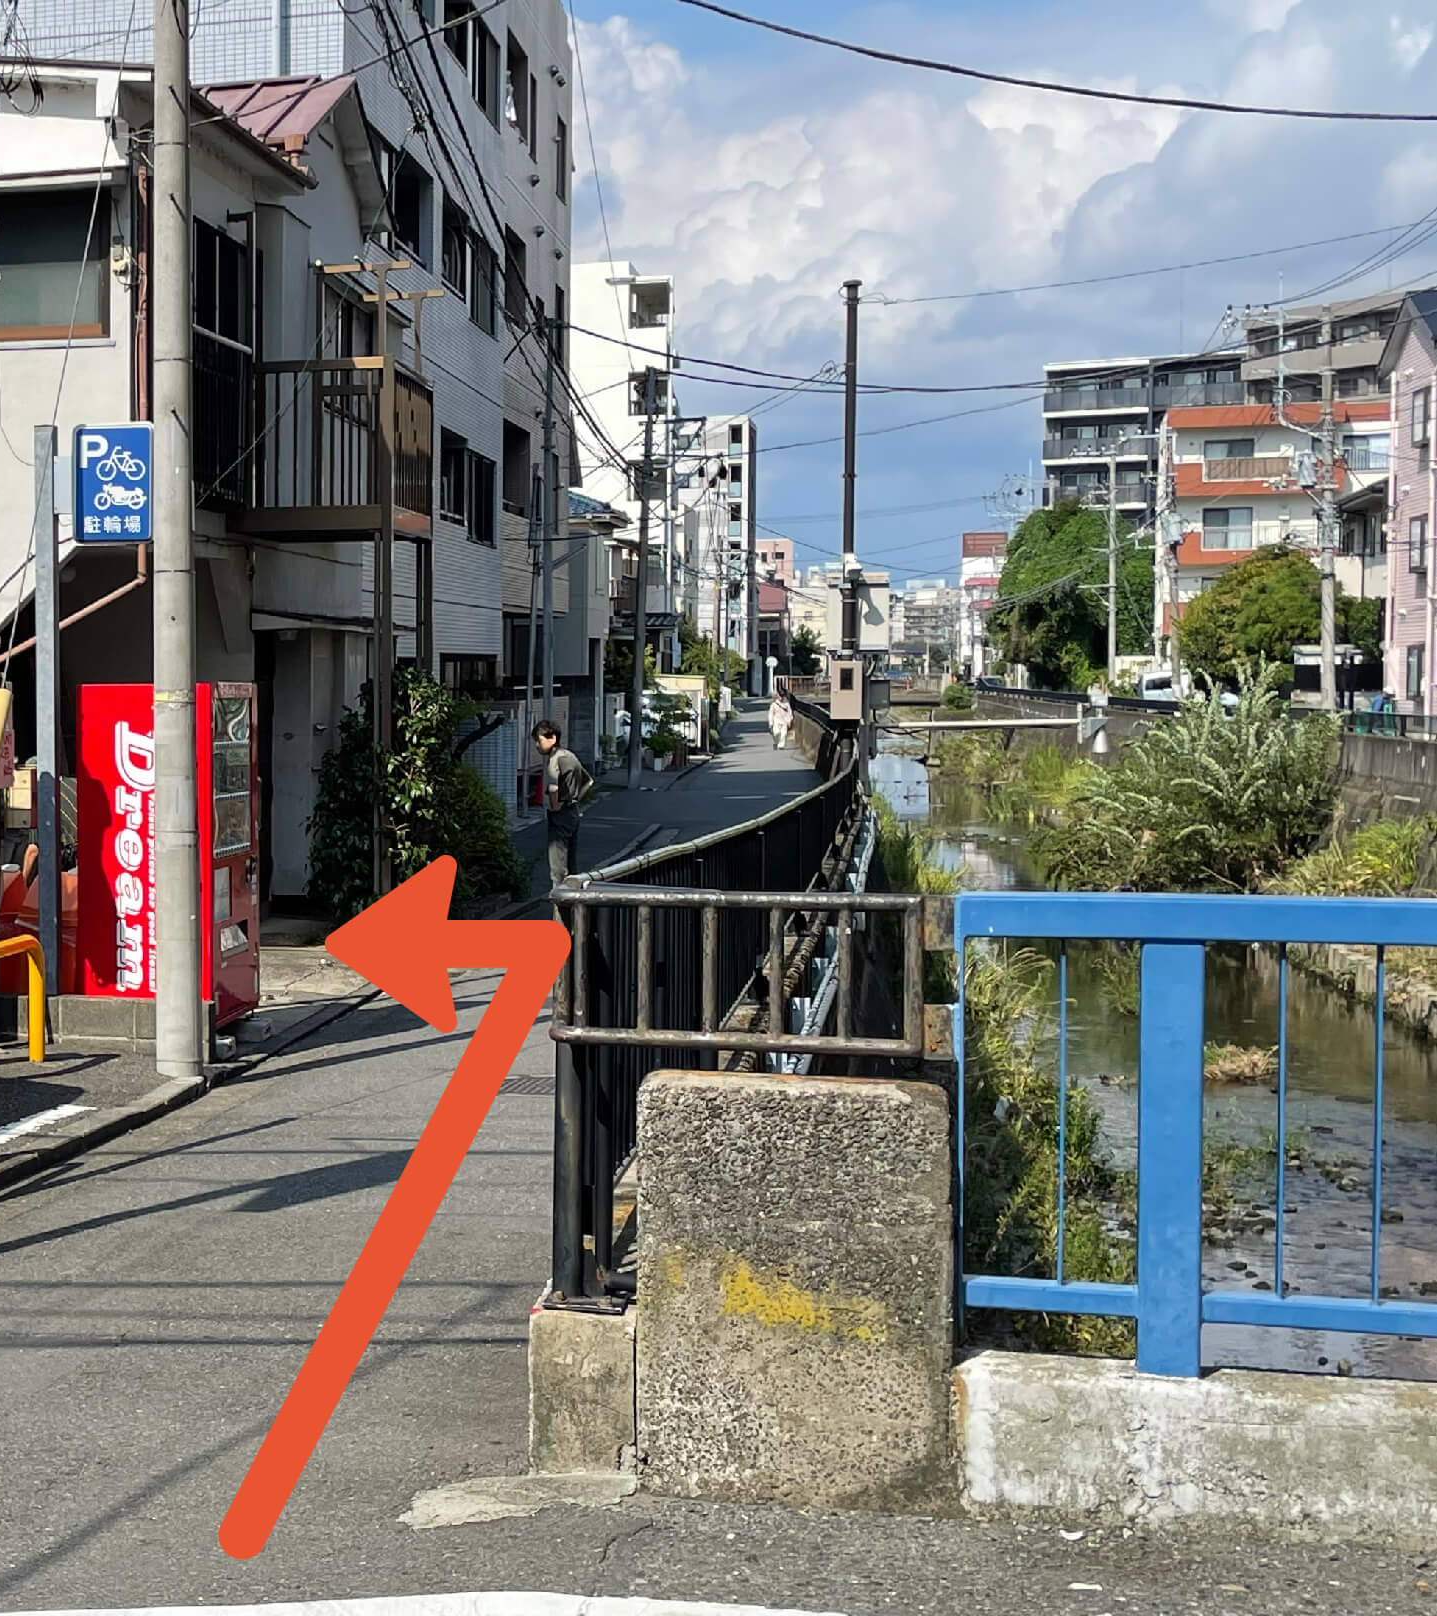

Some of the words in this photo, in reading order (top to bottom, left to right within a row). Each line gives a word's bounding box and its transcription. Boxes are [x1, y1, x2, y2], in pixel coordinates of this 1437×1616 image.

[80, 434, 109, 469] P
[83, 515, 141, 534] 駐輪場
[114, 720, 156, 992] Dream
